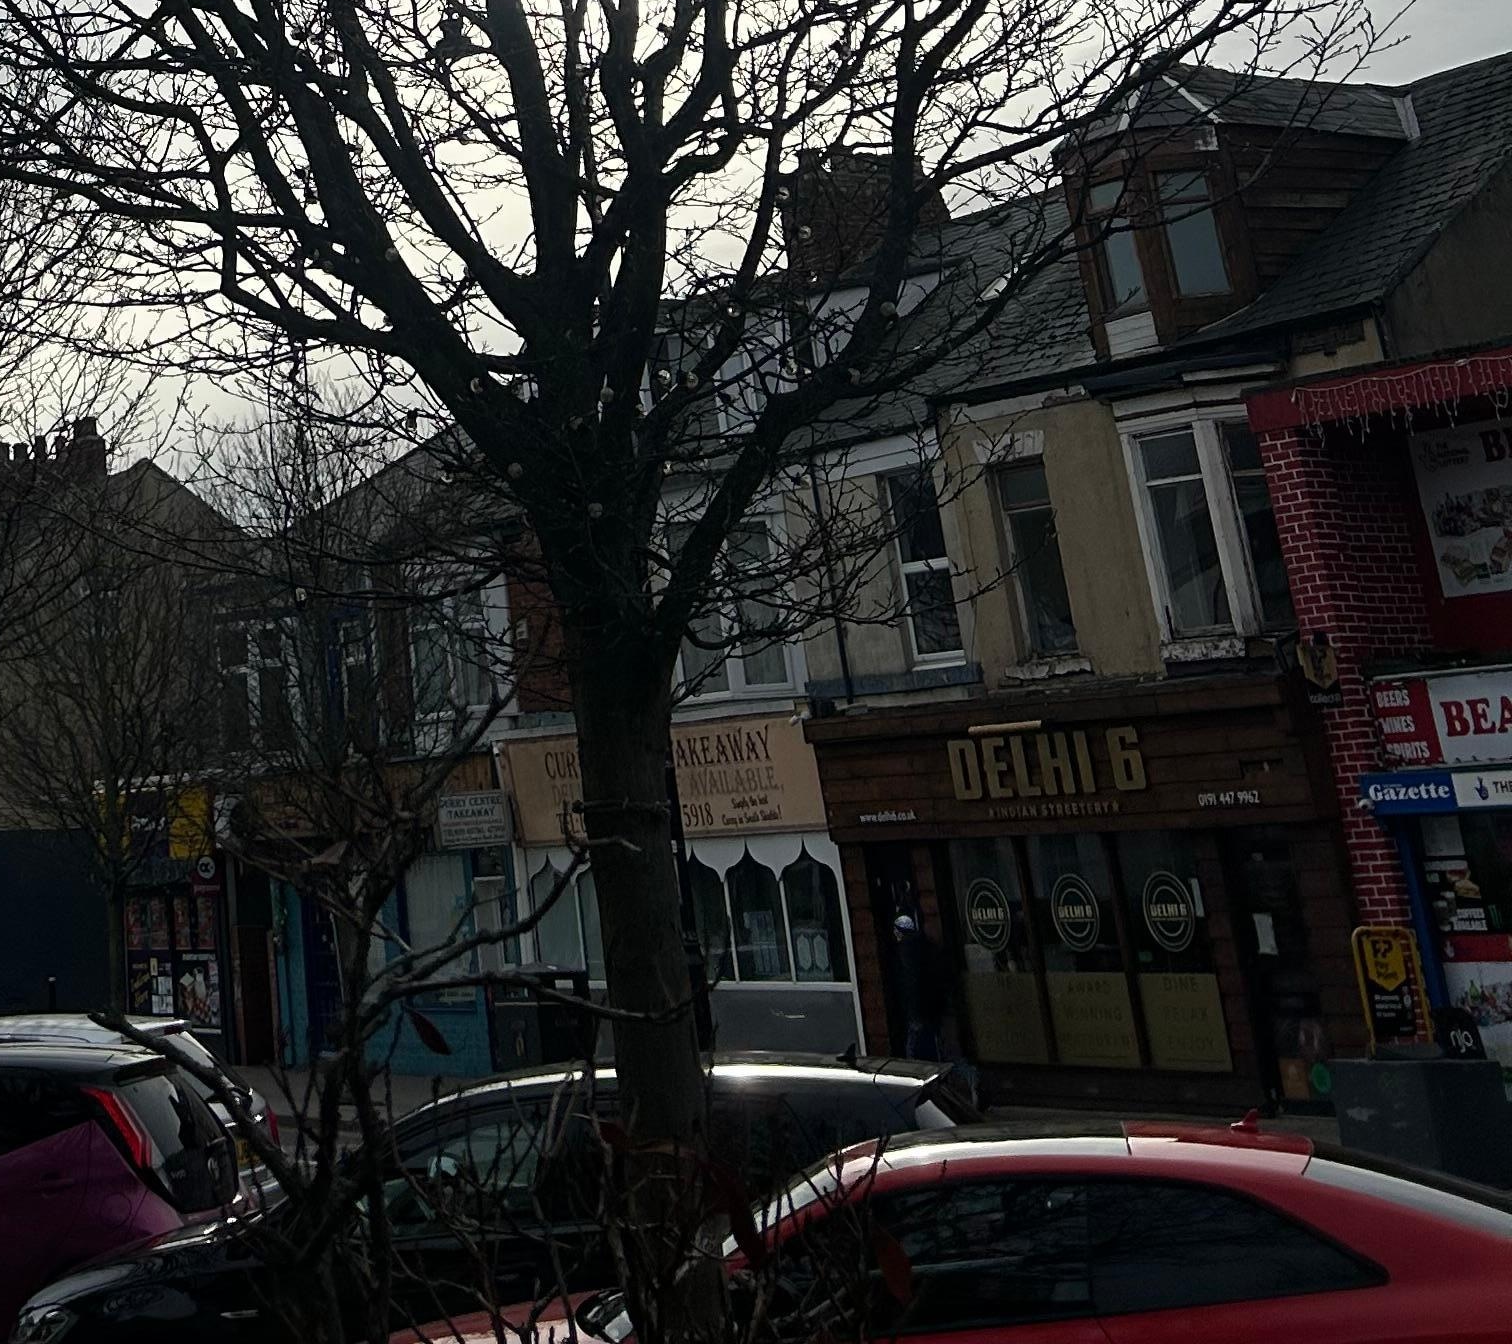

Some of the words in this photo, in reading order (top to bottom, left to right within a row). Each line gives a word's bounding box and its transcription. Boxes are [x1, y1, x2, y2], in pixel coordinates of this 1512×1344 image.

[1375, 690, 1410, 708] BEERS
[675, 723, 772, 768] AKEAWAY
[1385, 741, 1431, 760] SPIRITS
[946, 729, 1097, 800] DELHI
[1104, 724, 1148, 791] 6
[1198, 793, 1218, 808] 0191
[1368, 784, 1451, 801] Gazette
[469, 795, 503, 807] CENTRE
[448, 807, 495, 820] TAKEAWAY
[997, 804, 1037, 818] INDIAN
[1041, 801, 1110, 817] STREETERY
[972, 906, 997, 921] DELHI
[1057, 904, 1084, 919] DELHI
[1150, 904, 1179, 919] DELHI
[1162, 976, 1199, 992] DINE
